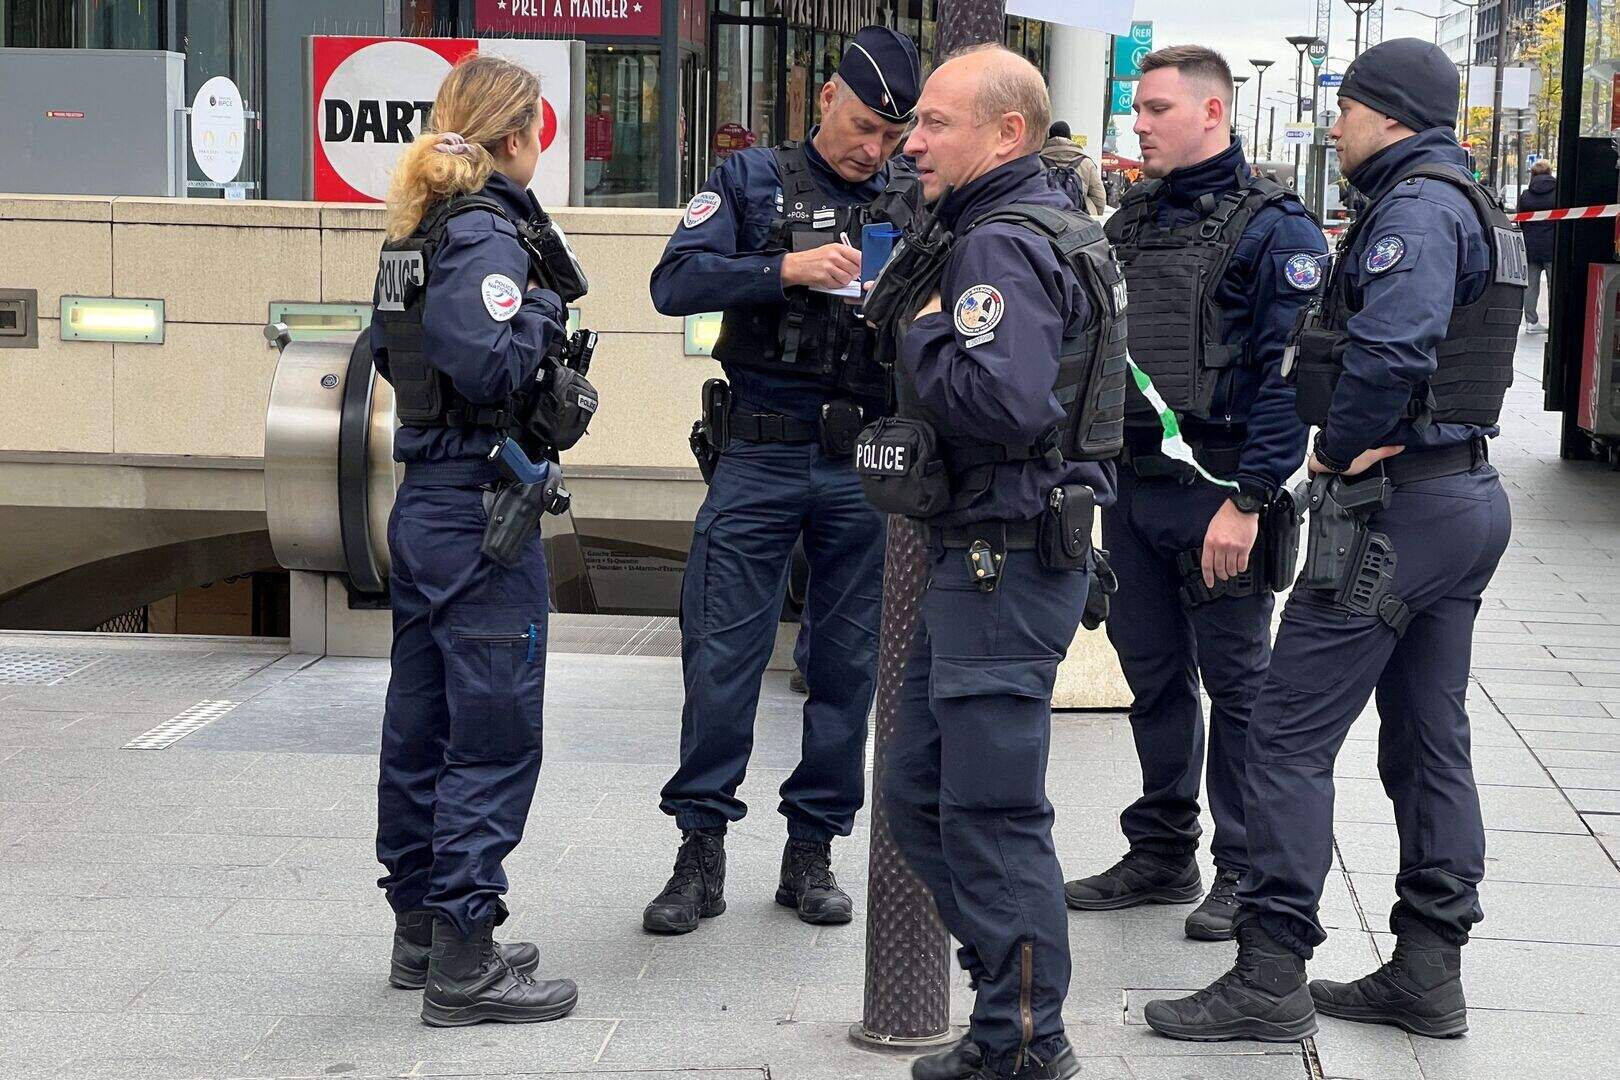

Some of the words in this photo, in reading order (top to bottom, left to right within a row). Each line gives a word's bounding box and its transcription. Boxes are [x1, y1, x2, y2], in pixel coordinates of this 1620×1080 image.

[553, 0, 563, 17] A
[570, 0, 628, 18] MANGER
[1135, 28, 1152, 38] RER
[1310, 45, 1326, 54] BUS
[1121, 96, 1131, 105] M
[856, 444, 905, 471] POLICE
